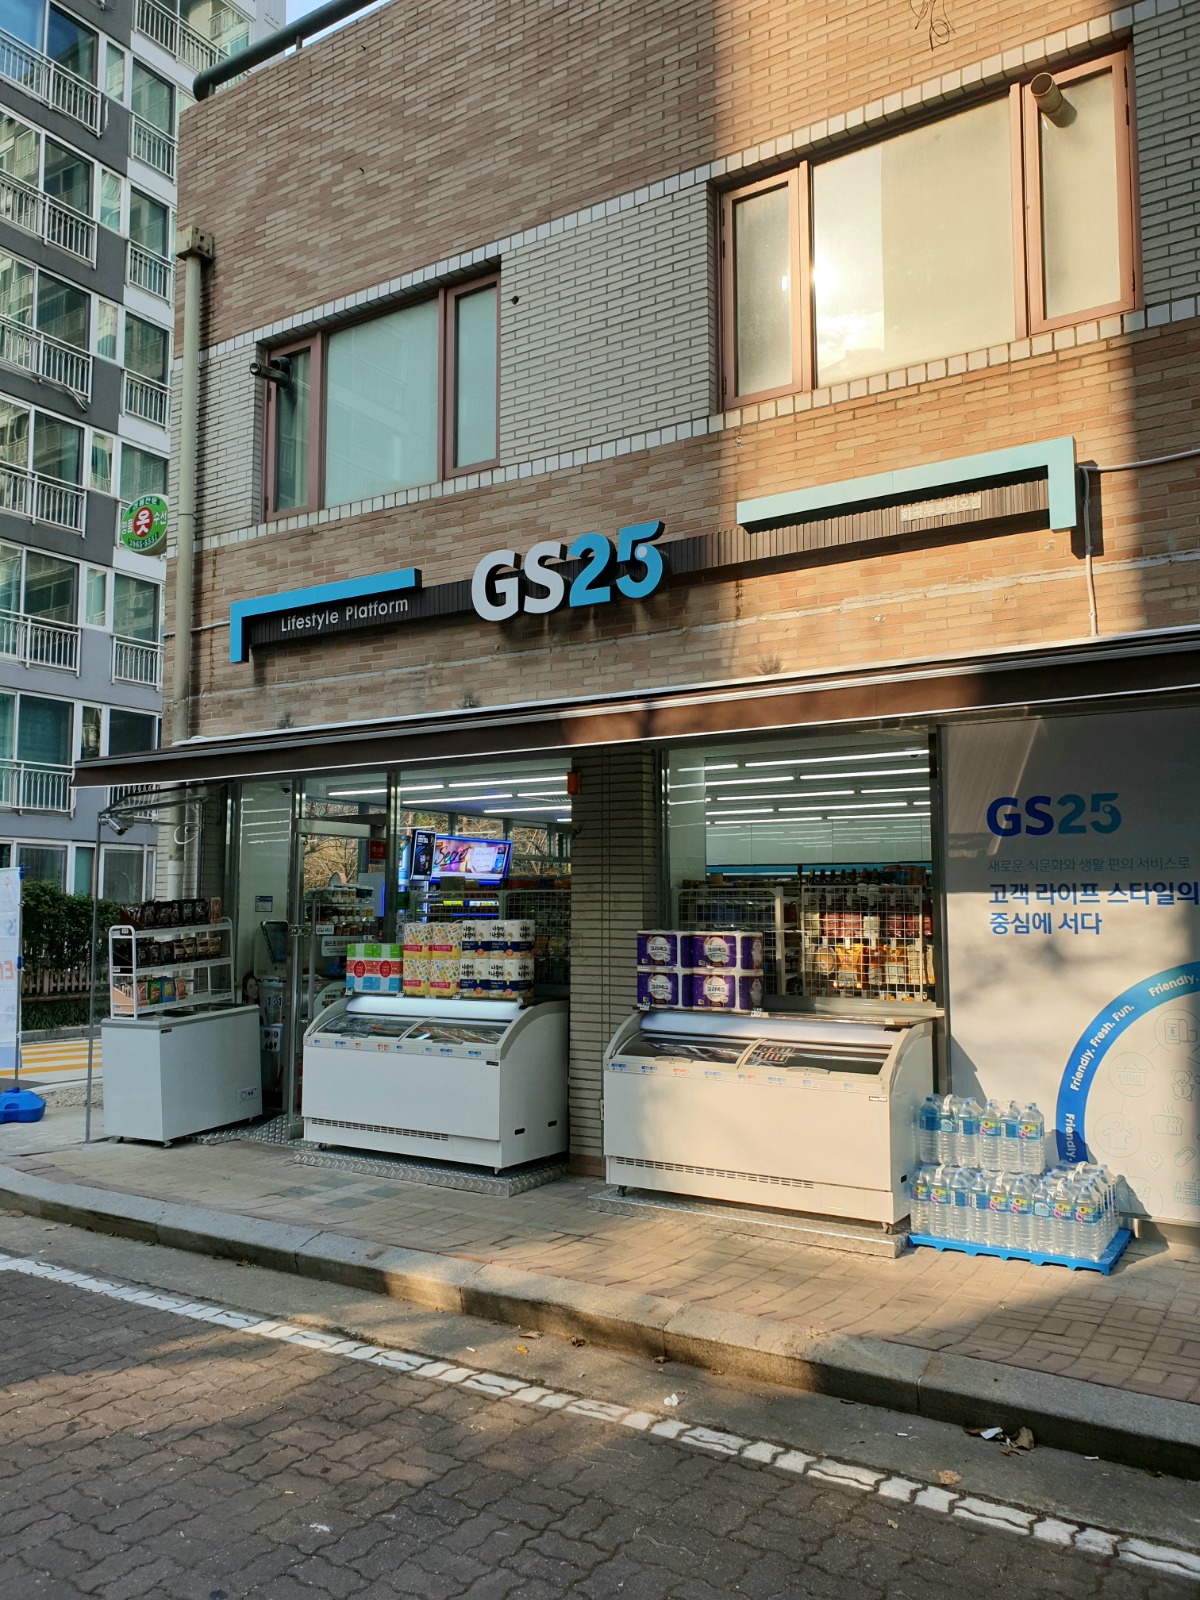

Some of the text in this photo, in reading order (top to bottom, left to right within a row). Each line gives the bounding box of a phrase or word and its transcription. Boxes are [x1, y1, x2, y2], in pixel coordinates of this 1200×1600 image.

[136, 510, 150, 535] 옷
[153, 510, 167, 526] 수선
[471, 520, 665, 621] GS25
[281, 599, 408, 631] Lifestyle Platform
[986, 792, 1122, 838] GS25
[988, 857, 1190, 873] 새로운 식문화와 생활 편의 서비스로
[988, 881, 1200, 906] 고객 라이프 스타일의
[989, 912, 1102, 935] 중심에 서다
[1070, 1004, 1135, 1091] Friendly. Fresh. Fun.
